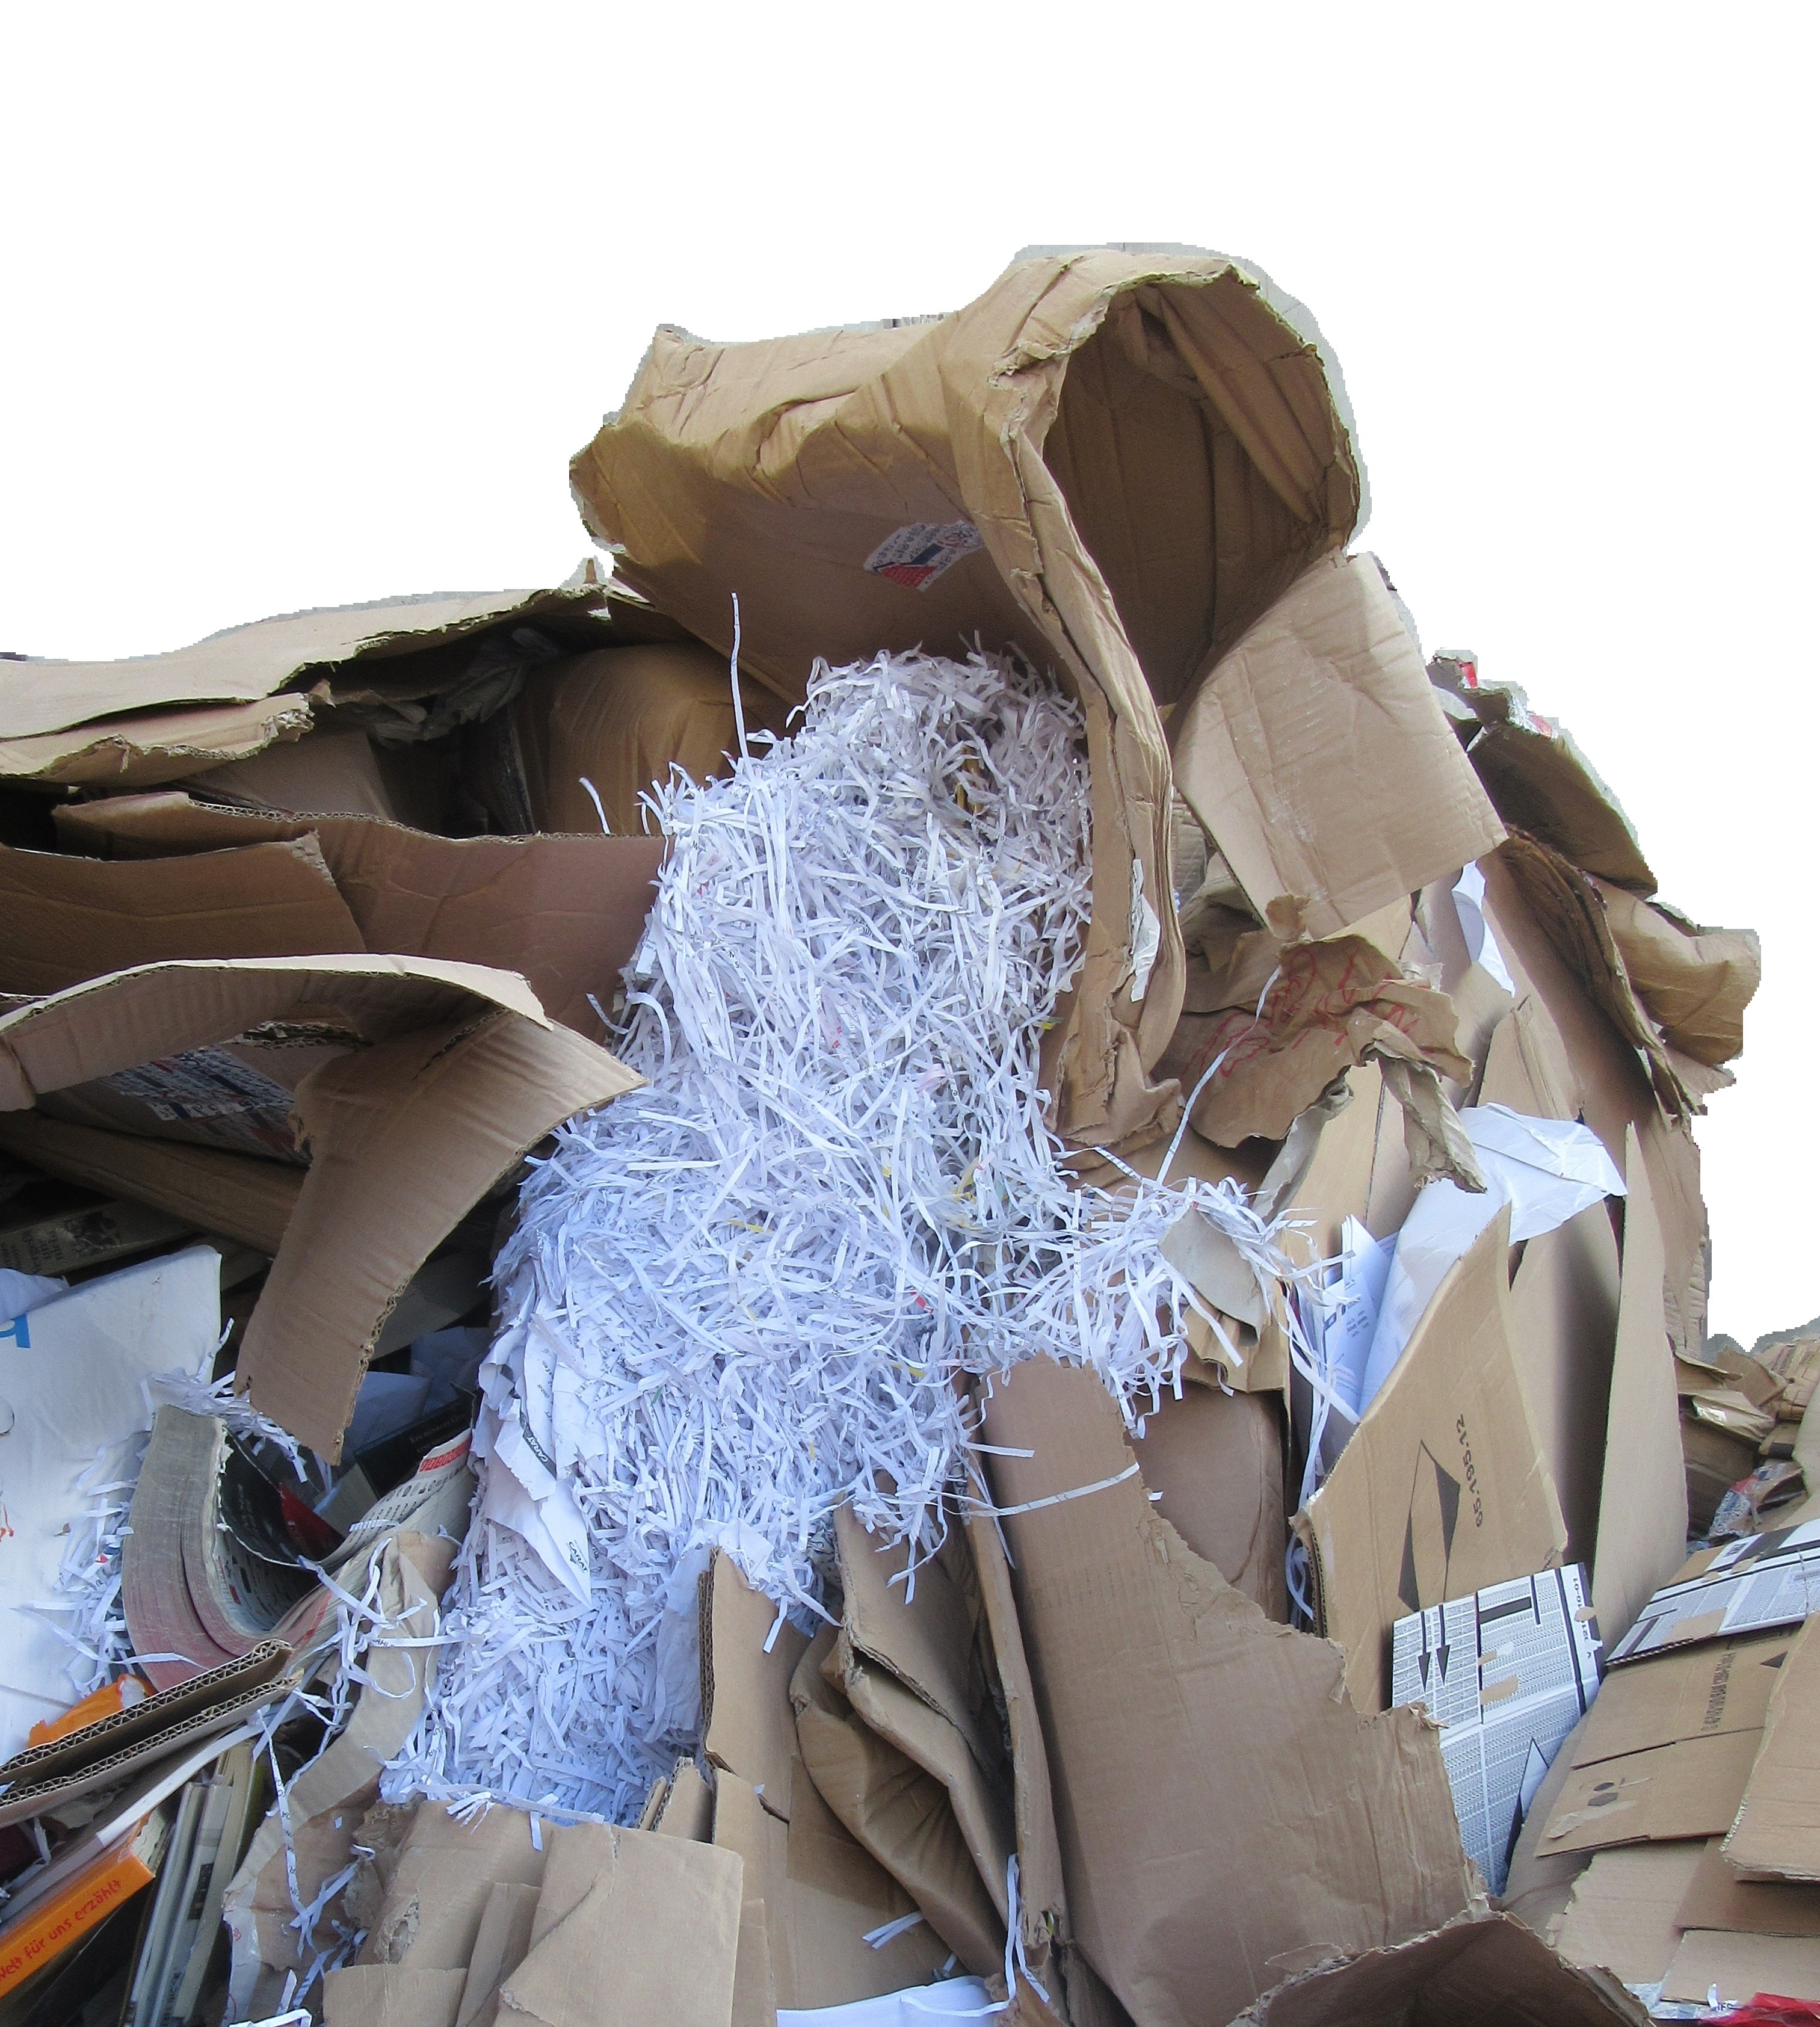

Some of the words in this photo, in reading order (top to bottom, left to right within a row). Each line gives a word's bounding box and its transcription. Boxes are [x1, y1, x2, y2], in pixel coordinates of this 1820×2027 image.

[526, 1436, 549, 1463] CARAT
[569, 1541, 588, 1572] CARAT
[23, 1938, 45, 1960] für
[49, 1918, 72, 1940] uns
[74, 1879, 122, 1921] erzählt
